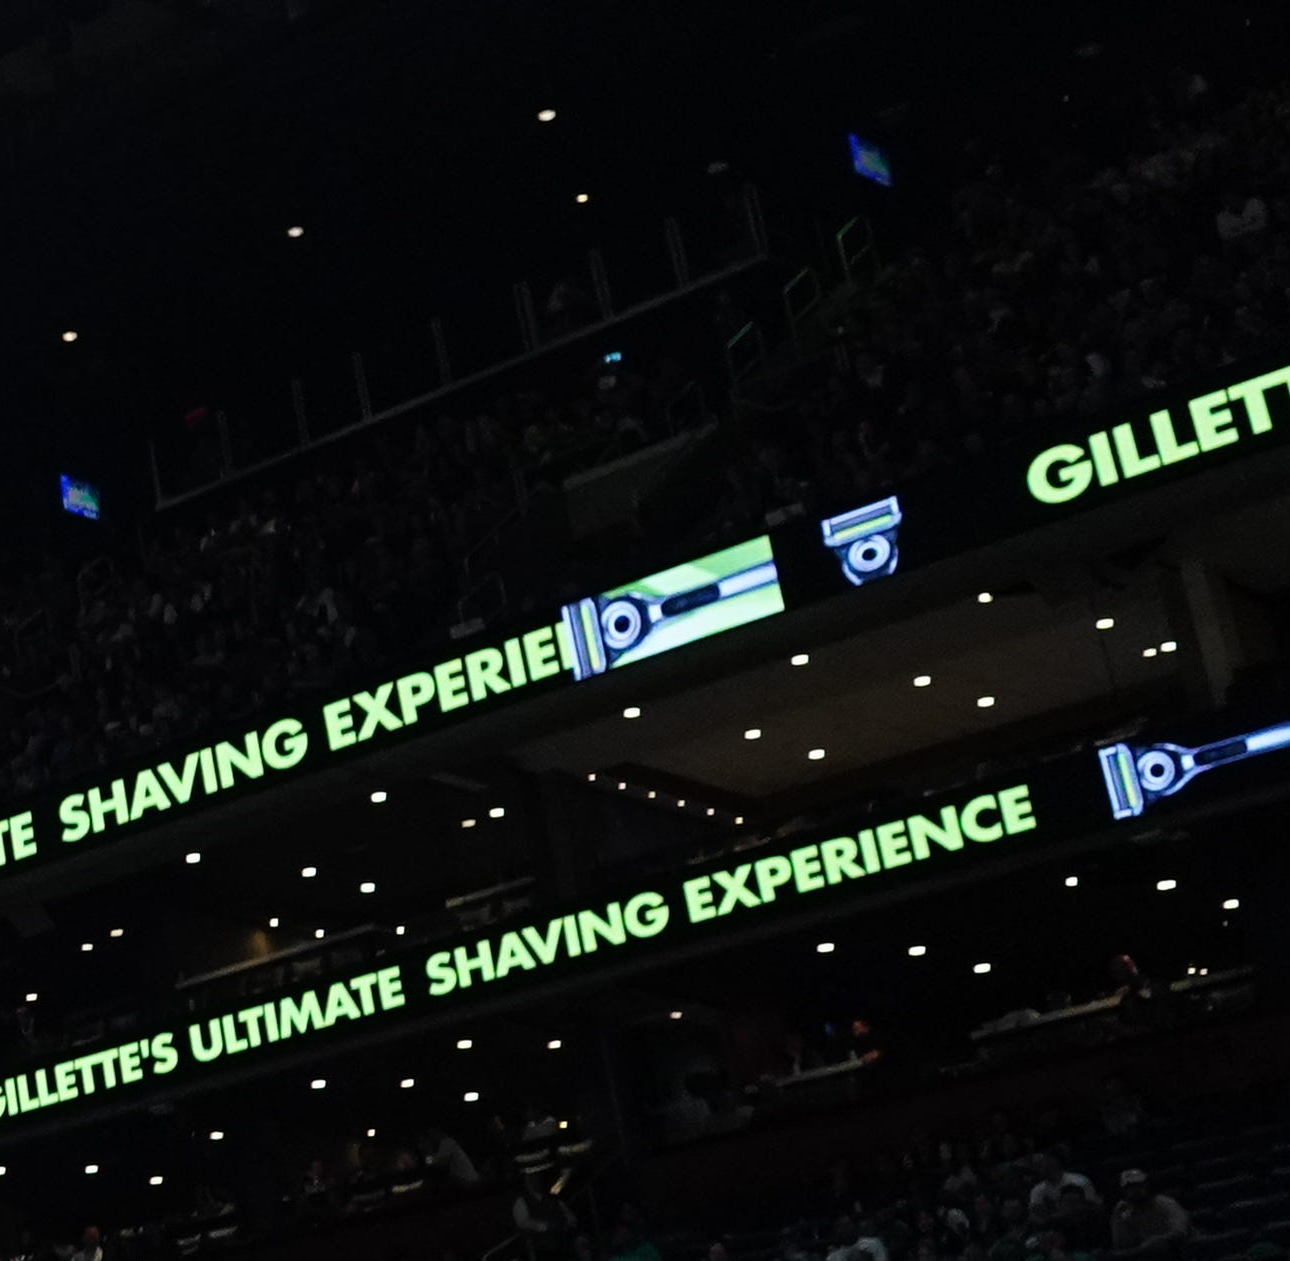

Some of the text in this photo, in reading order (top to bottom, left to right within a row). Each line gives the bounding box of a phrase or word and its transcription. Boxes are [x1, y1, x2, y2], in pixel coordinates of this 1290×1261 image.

[1027, 364, 1290, 504] GILLET
[59, 718, 308, 843] SHAVING
[323, 619, 576, 752] EXPERIE
[188, 965, 406, 1063] ULTIMATE
[425, 892, 671, 997] SHAVING
[683, 783, 1038, 934] EXPERIENCE
